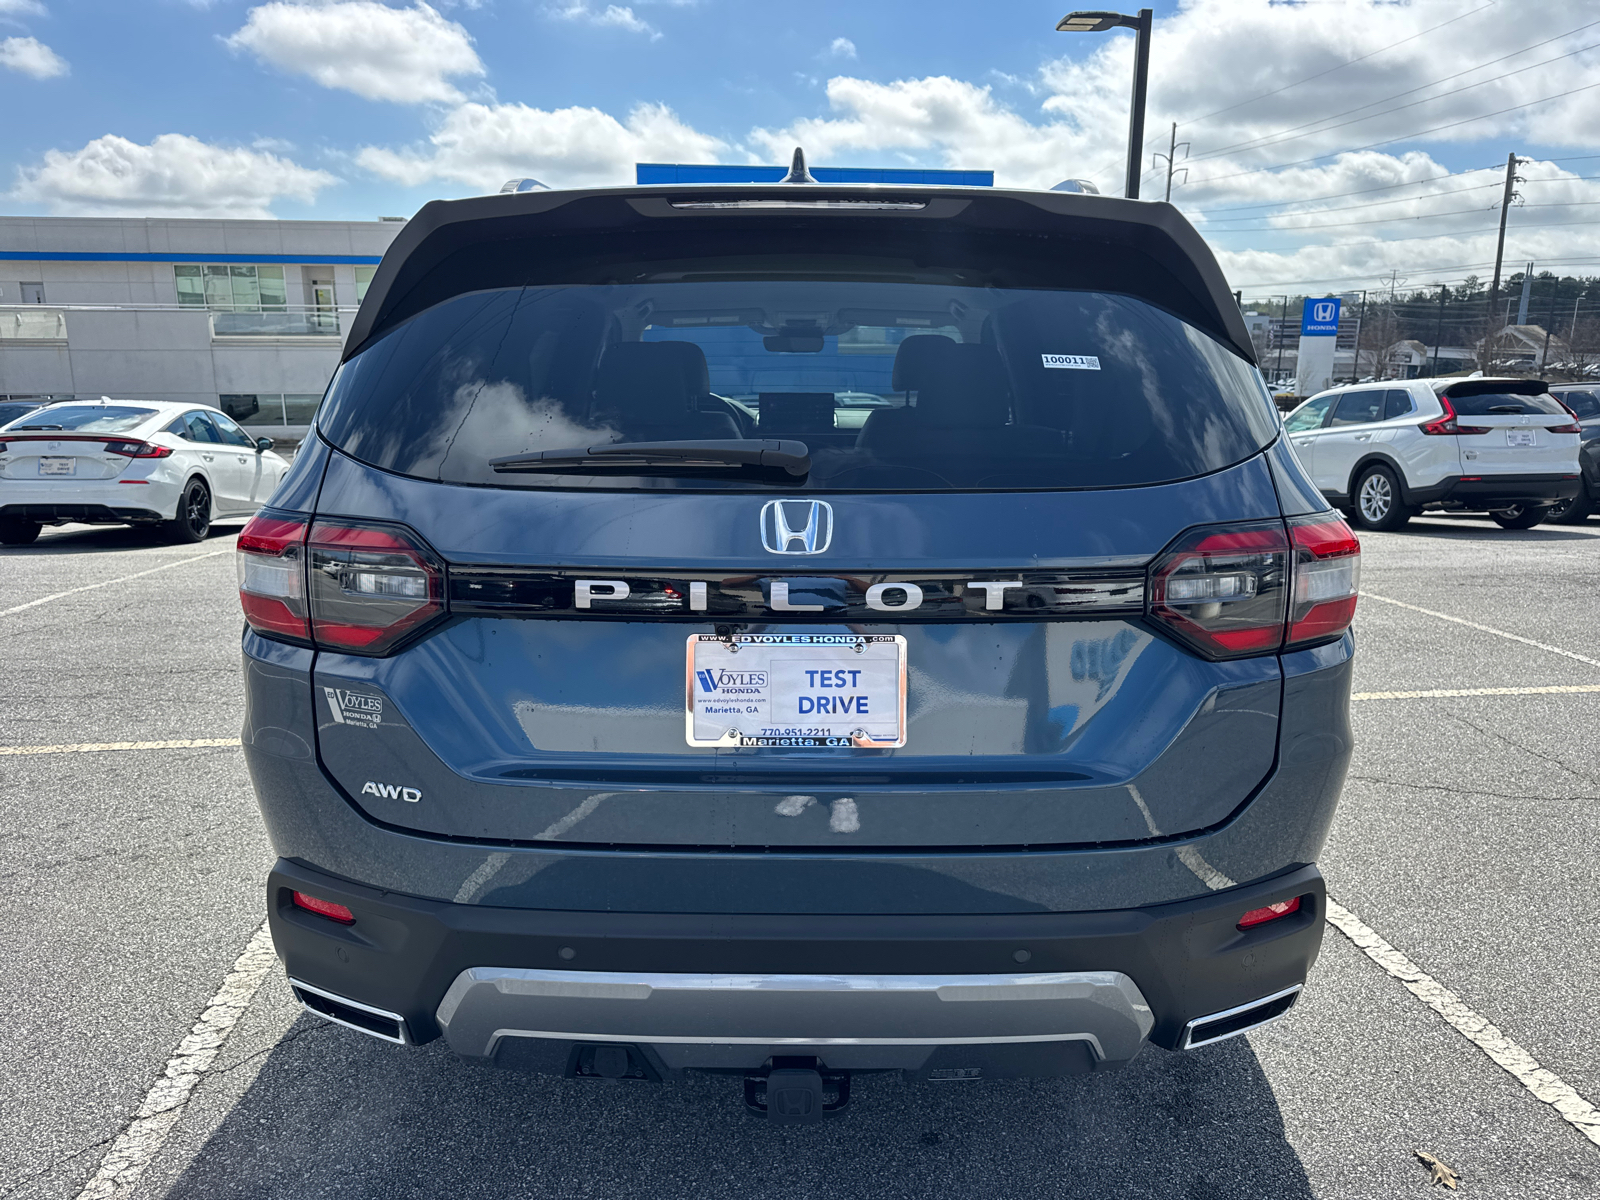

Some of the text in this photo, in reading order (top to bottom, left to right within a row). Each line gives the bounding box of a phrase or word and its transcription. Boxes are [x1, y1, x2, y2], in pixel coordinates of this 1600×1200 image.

[1043, 355, 1086, 364] 100011
[574, 579, 1023, 612] PILOT
[805, 669, 862, 689] TEST
[327, 691, 334, 699] ED
[705, 706, 759, 714] Marietta, GA
[798, 695, 869, 715] DRIVE
[343, 711, 372, 721] HONDA
[345, 719, 367, 728] Marietta,
[760, 728, 832, 736] 770-951-2211
[742, 736, 850, 747] Marietta, GA
[361, 781, 421, 802] AWD
